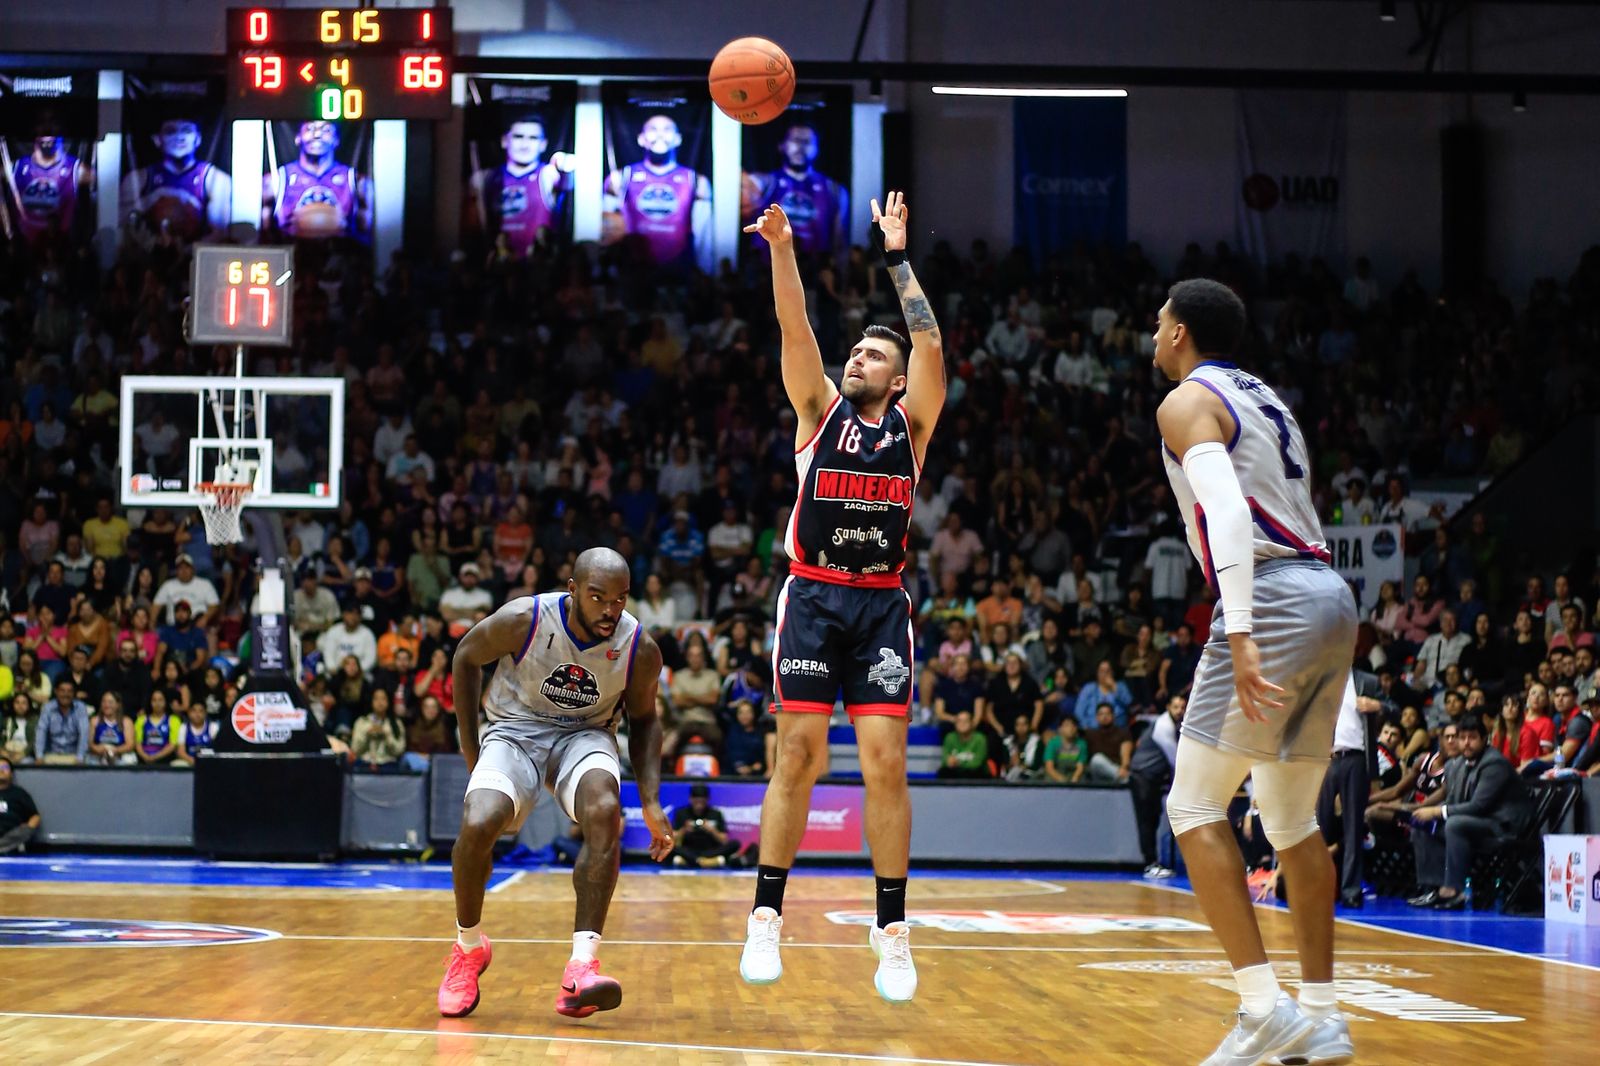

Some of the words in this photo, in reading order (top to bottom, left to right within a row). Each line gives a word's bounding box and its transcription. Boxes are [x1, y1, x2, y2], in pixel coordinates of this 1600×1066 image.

[249, 11, 268, 42] 0
[320, 10, 341, 43] 6
[352, 10, 380, 43] 15
[421, 12, 431, 40] 1
[243, 56, 282, 89] 73
[329, 58, 350, 87] 4
[403, 56, 443, 89] 66
[228, 261, 243, 284] 6
[250, 261, 270, 285] 15
[229, 287, 270, 327] 17
[837, 418, 863, 454] 18
[816, 469, 911, 508] MINEROS
[844, 502, 889, 512] ZACATCAS
[547, 633, 555, 649] 1
[792, 659, 830, 673] DERAL
[542, 682, 599, 705] GAMBUSINOS
